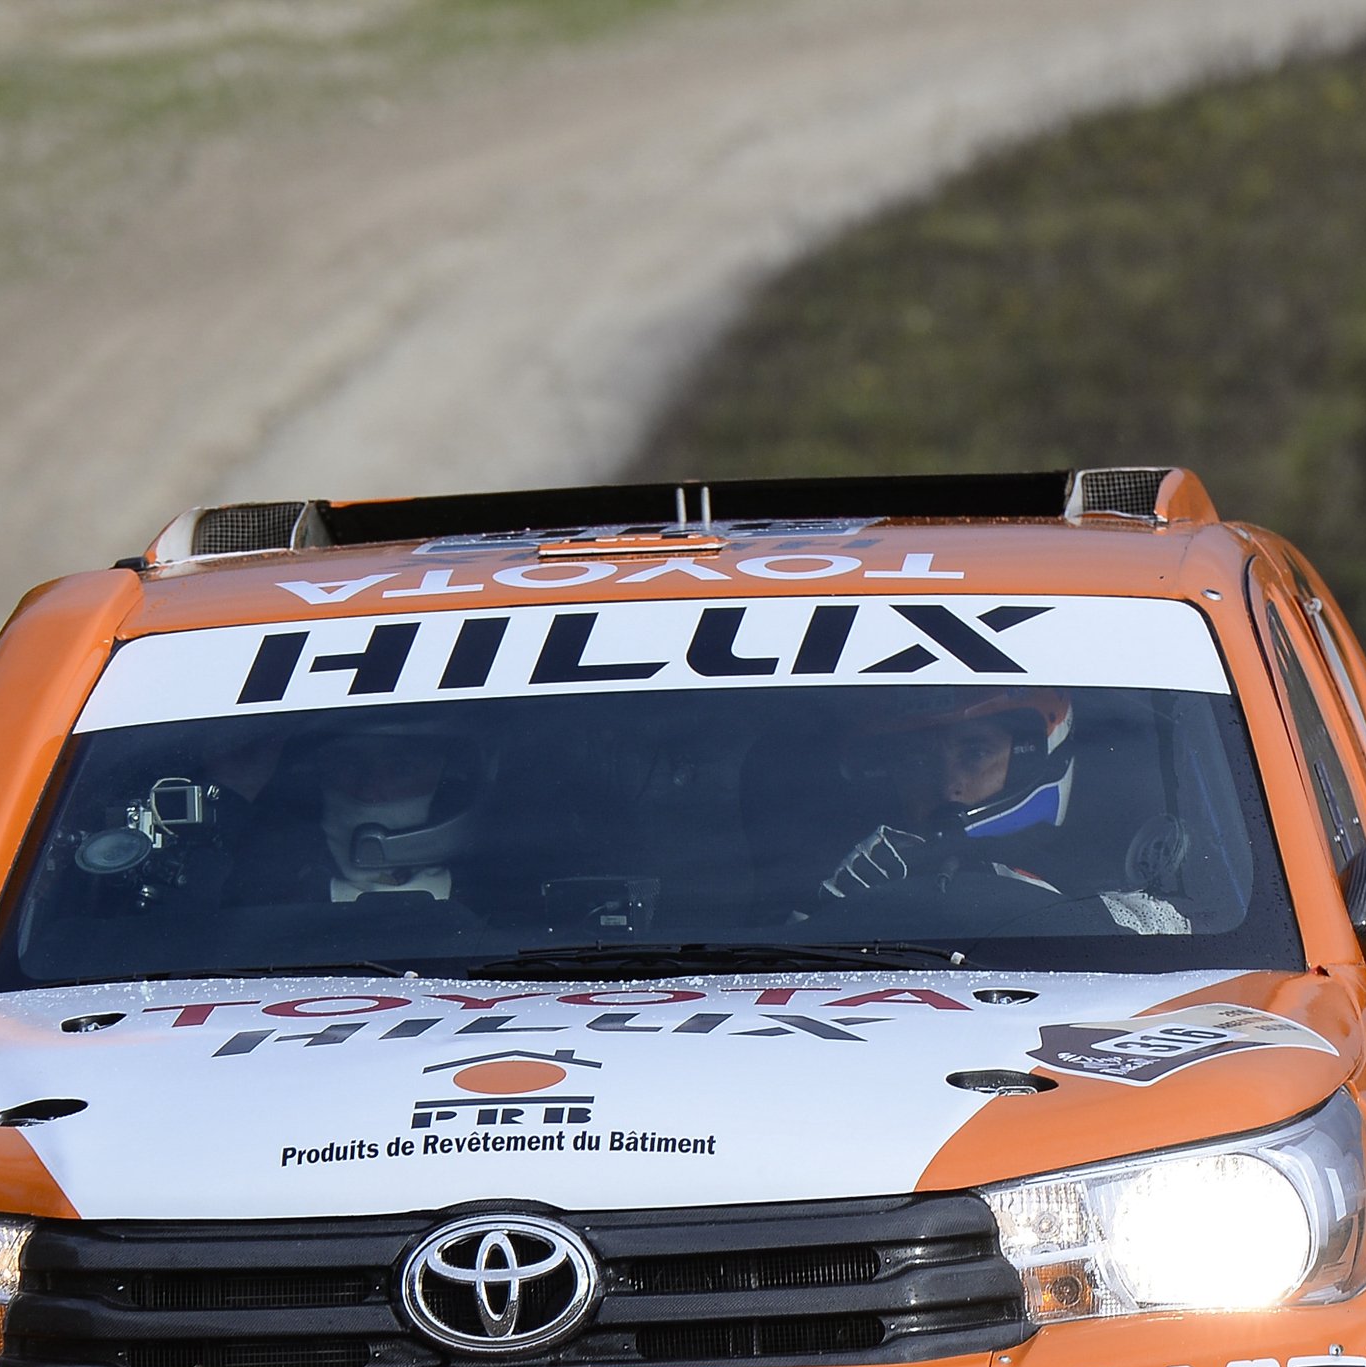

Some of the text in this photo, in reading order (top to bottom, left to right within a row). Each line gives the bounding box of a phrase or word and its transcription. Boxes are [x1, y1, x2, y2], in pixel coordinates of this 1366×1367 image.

[275, 552, 965, 606] TOYOTA
[235, 603, 1055, 705] HILUX
[142, 987, 974, 1028] TOYOTA
[211, 1012, 897, 1058] HILUX
[1113, 1027, 1228, 1053] 316
[411, 1106, 592, 1129] PRB
[280, 1131, 716, 1167] Produits de Revêtement du Bâtiment
